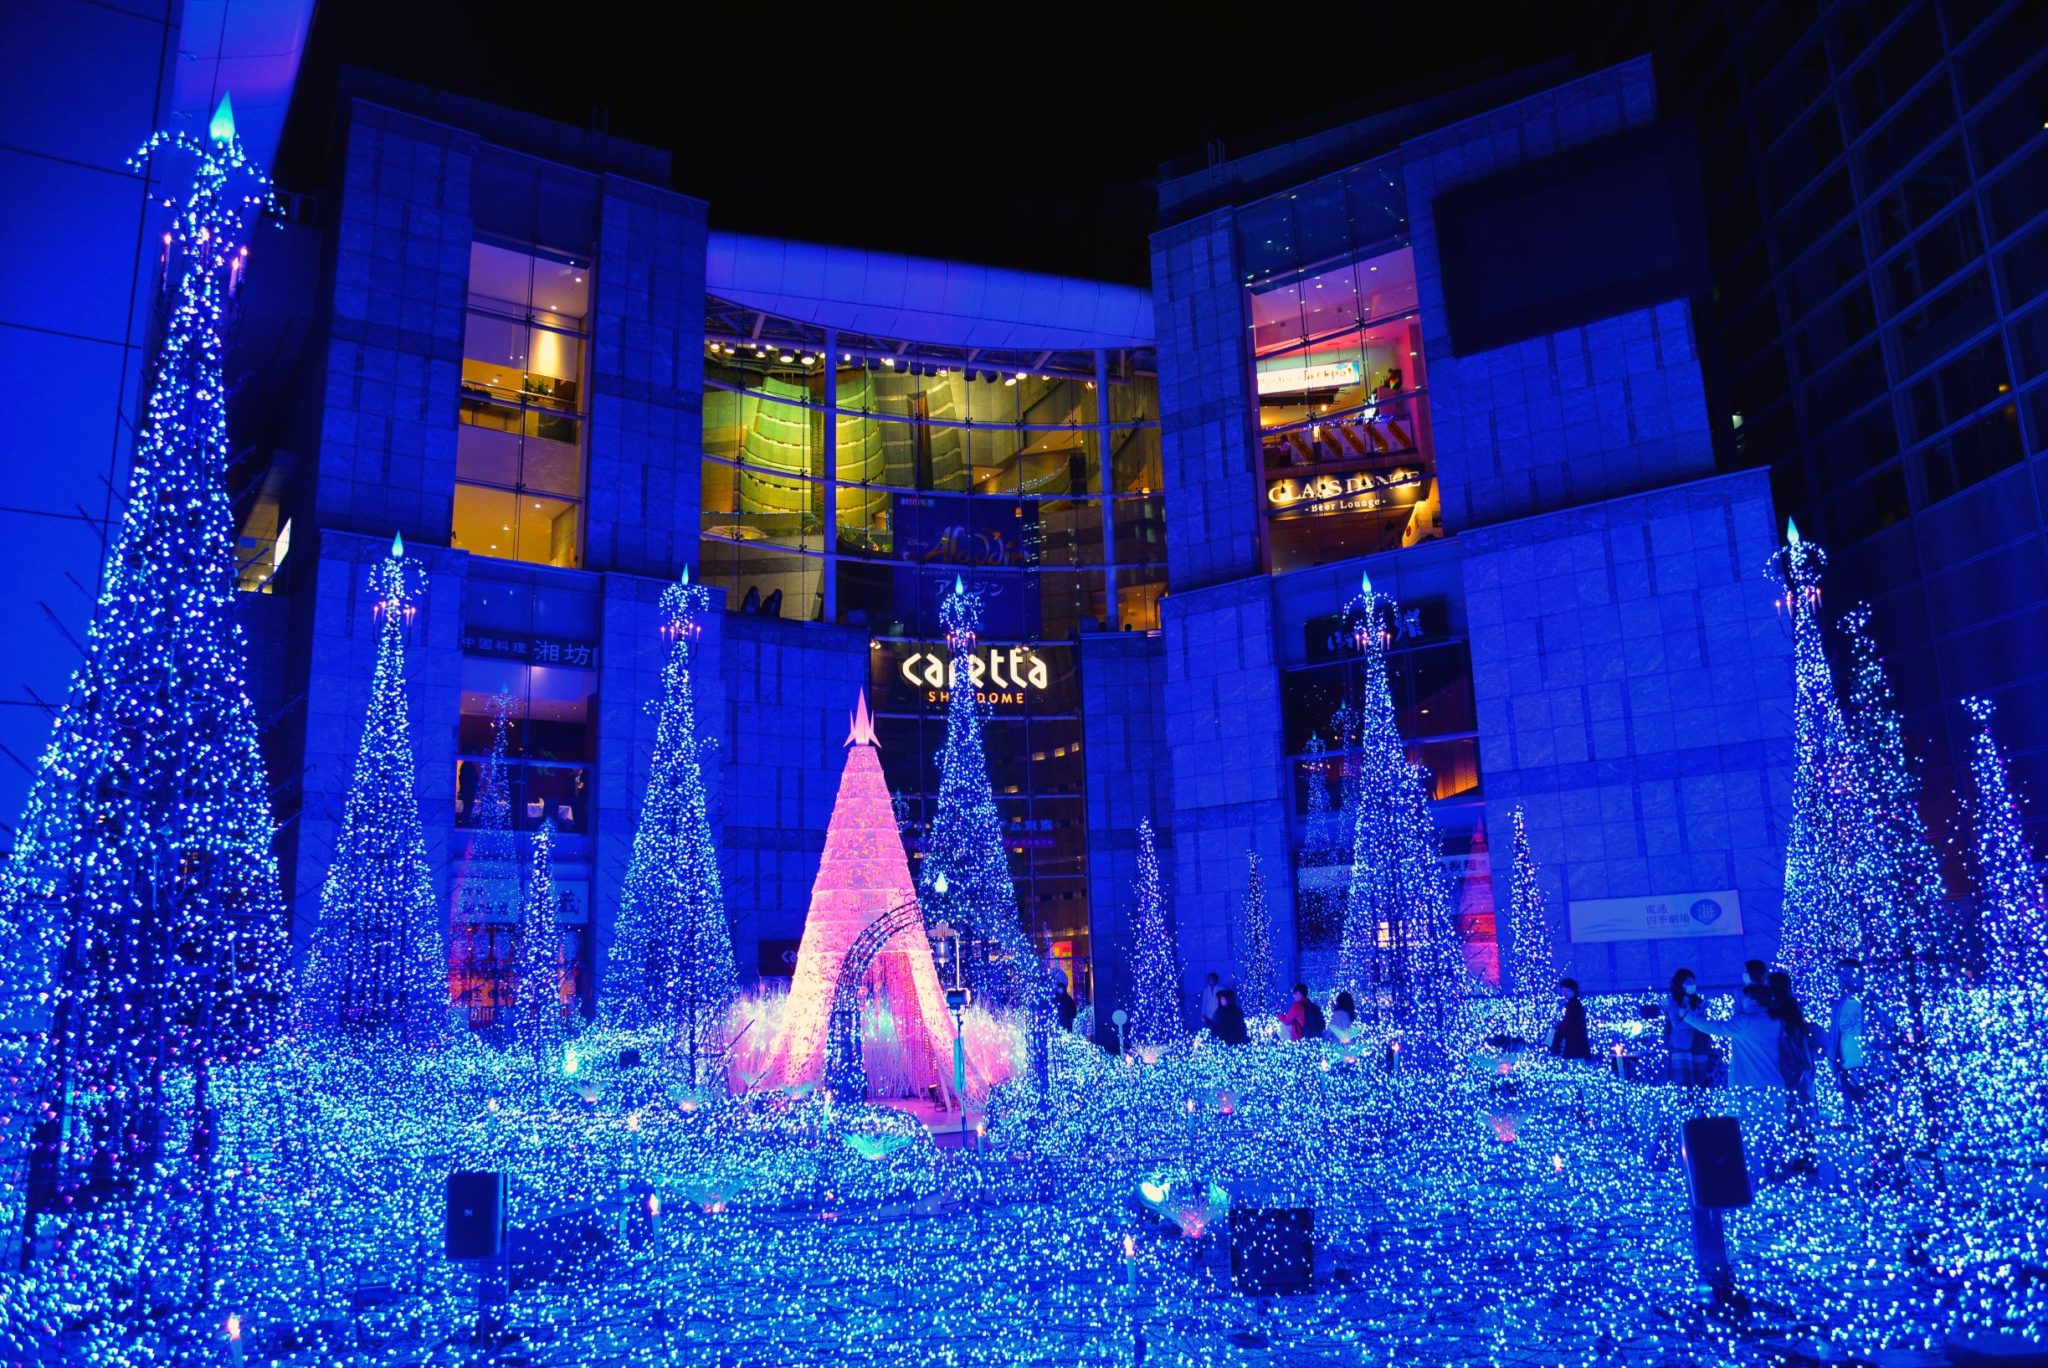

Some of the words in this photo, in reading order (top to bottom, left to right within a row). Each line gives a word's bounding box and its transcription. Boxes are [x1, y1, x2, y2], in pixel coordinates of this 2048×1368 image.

[1268, 480, 1342, 503] GLASS
[908, 526, 1027, 564] Aladdin
[533, 640, 591, 666] 湘坊
[928, 691, 1025, 704] SHDOME
